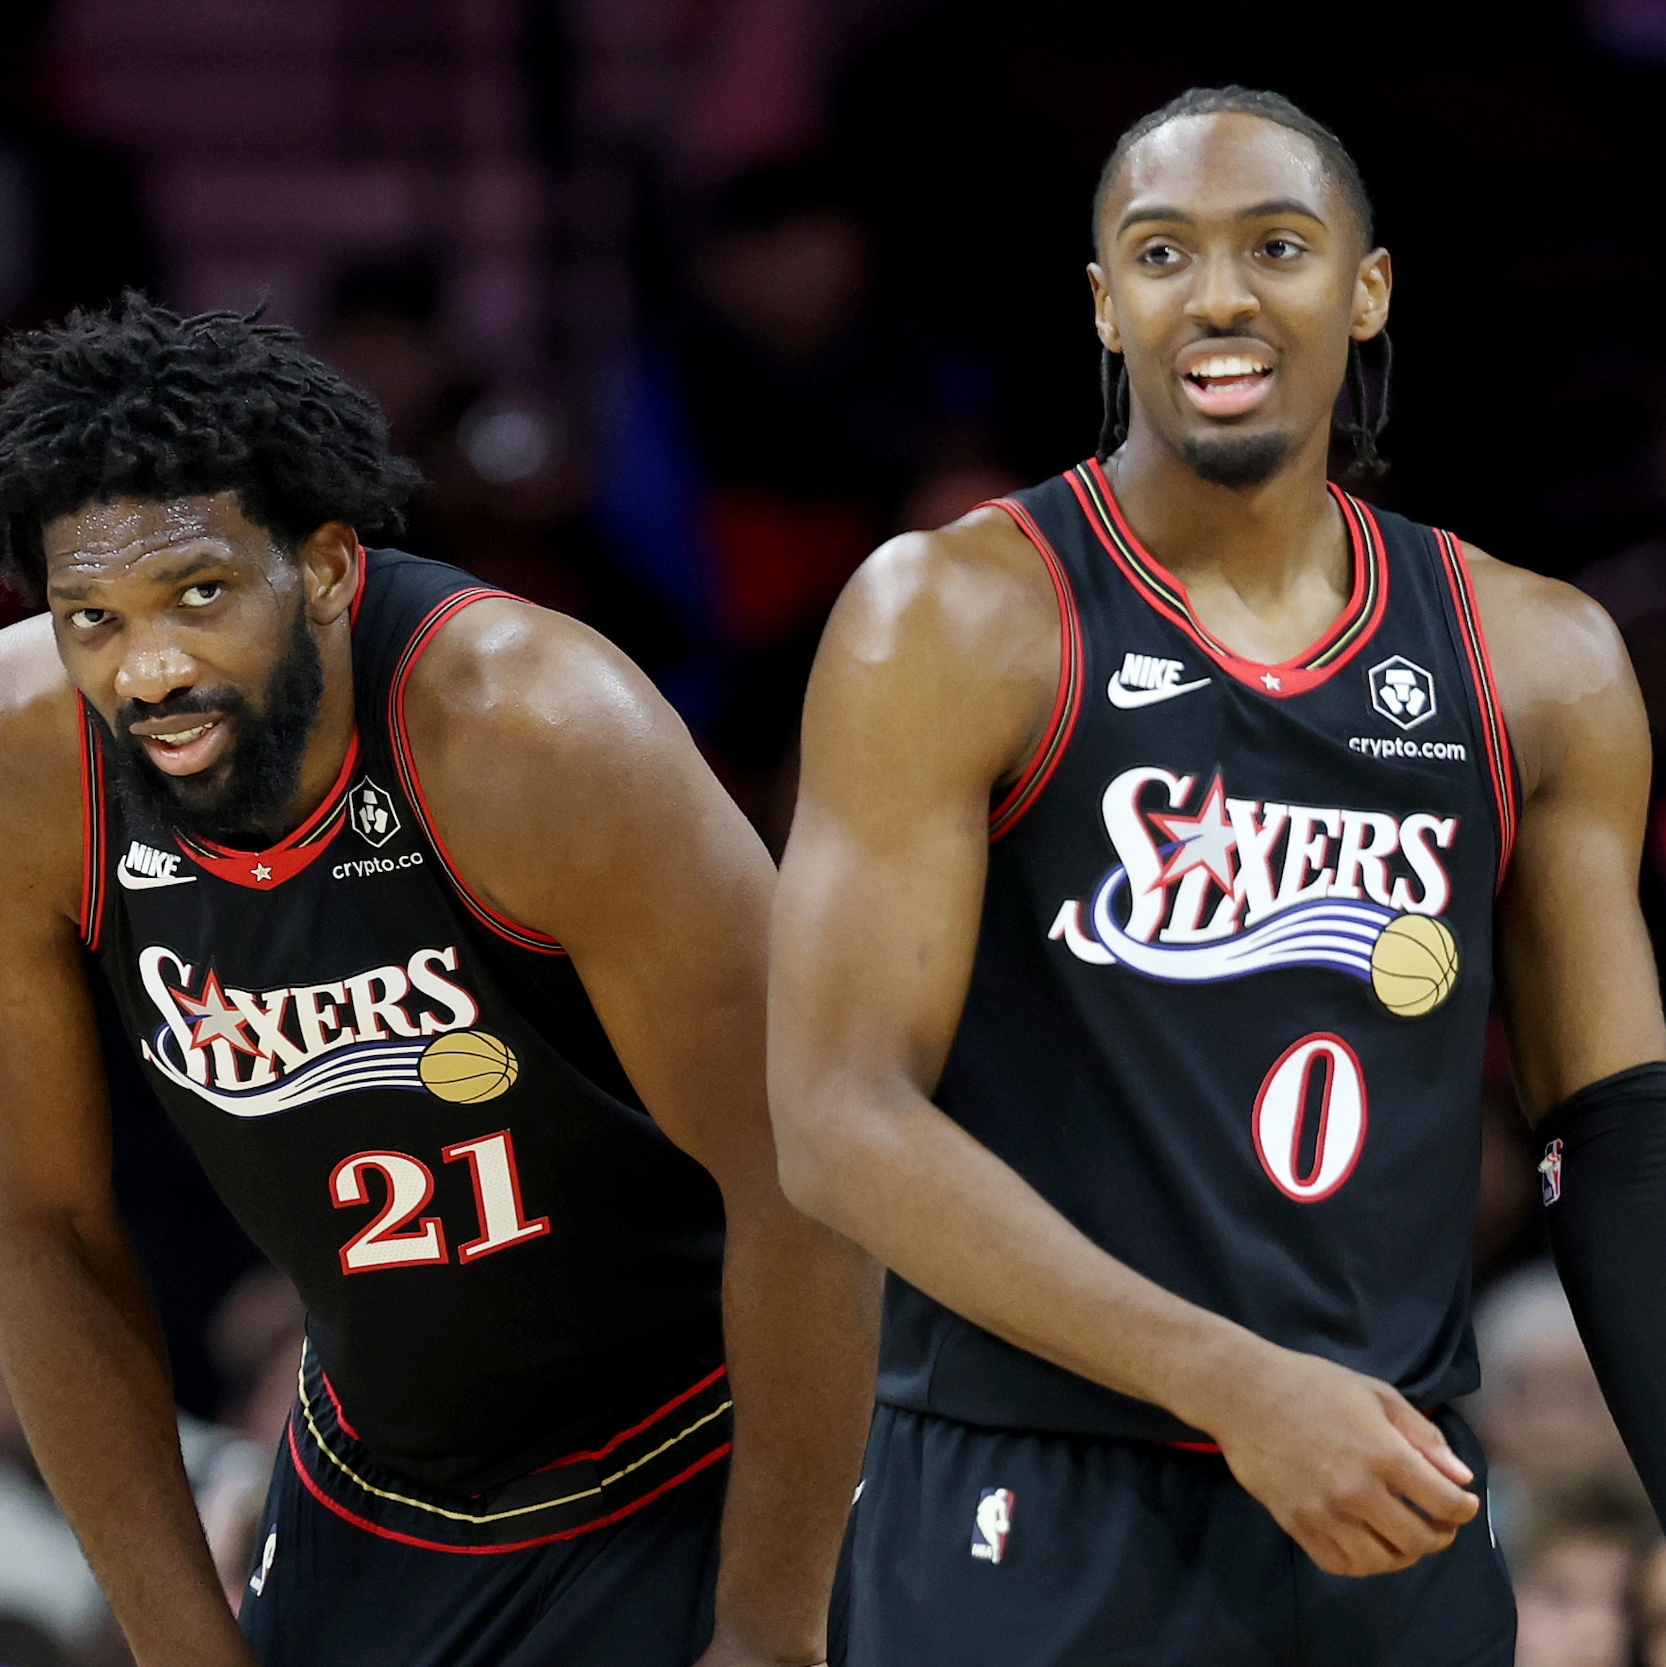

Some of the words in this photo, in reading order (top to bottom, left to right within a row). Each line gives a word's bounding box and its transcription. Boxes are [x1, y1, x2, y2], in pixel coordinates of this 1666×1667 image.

[1119, 652, 1185, 691] NIKE
[1348, 737, 1467, 761] crypto.com
[125, 840, 182, 880] NIKE
[332, 852, 424, 880] crypto.co
[1048, 766, 1460, 966] SIXERS
[138, 945, 480, 1092] SIXERS
[1251, 1031, 1369, 1203] 0
[328, 1128, 552, 1276] 21
